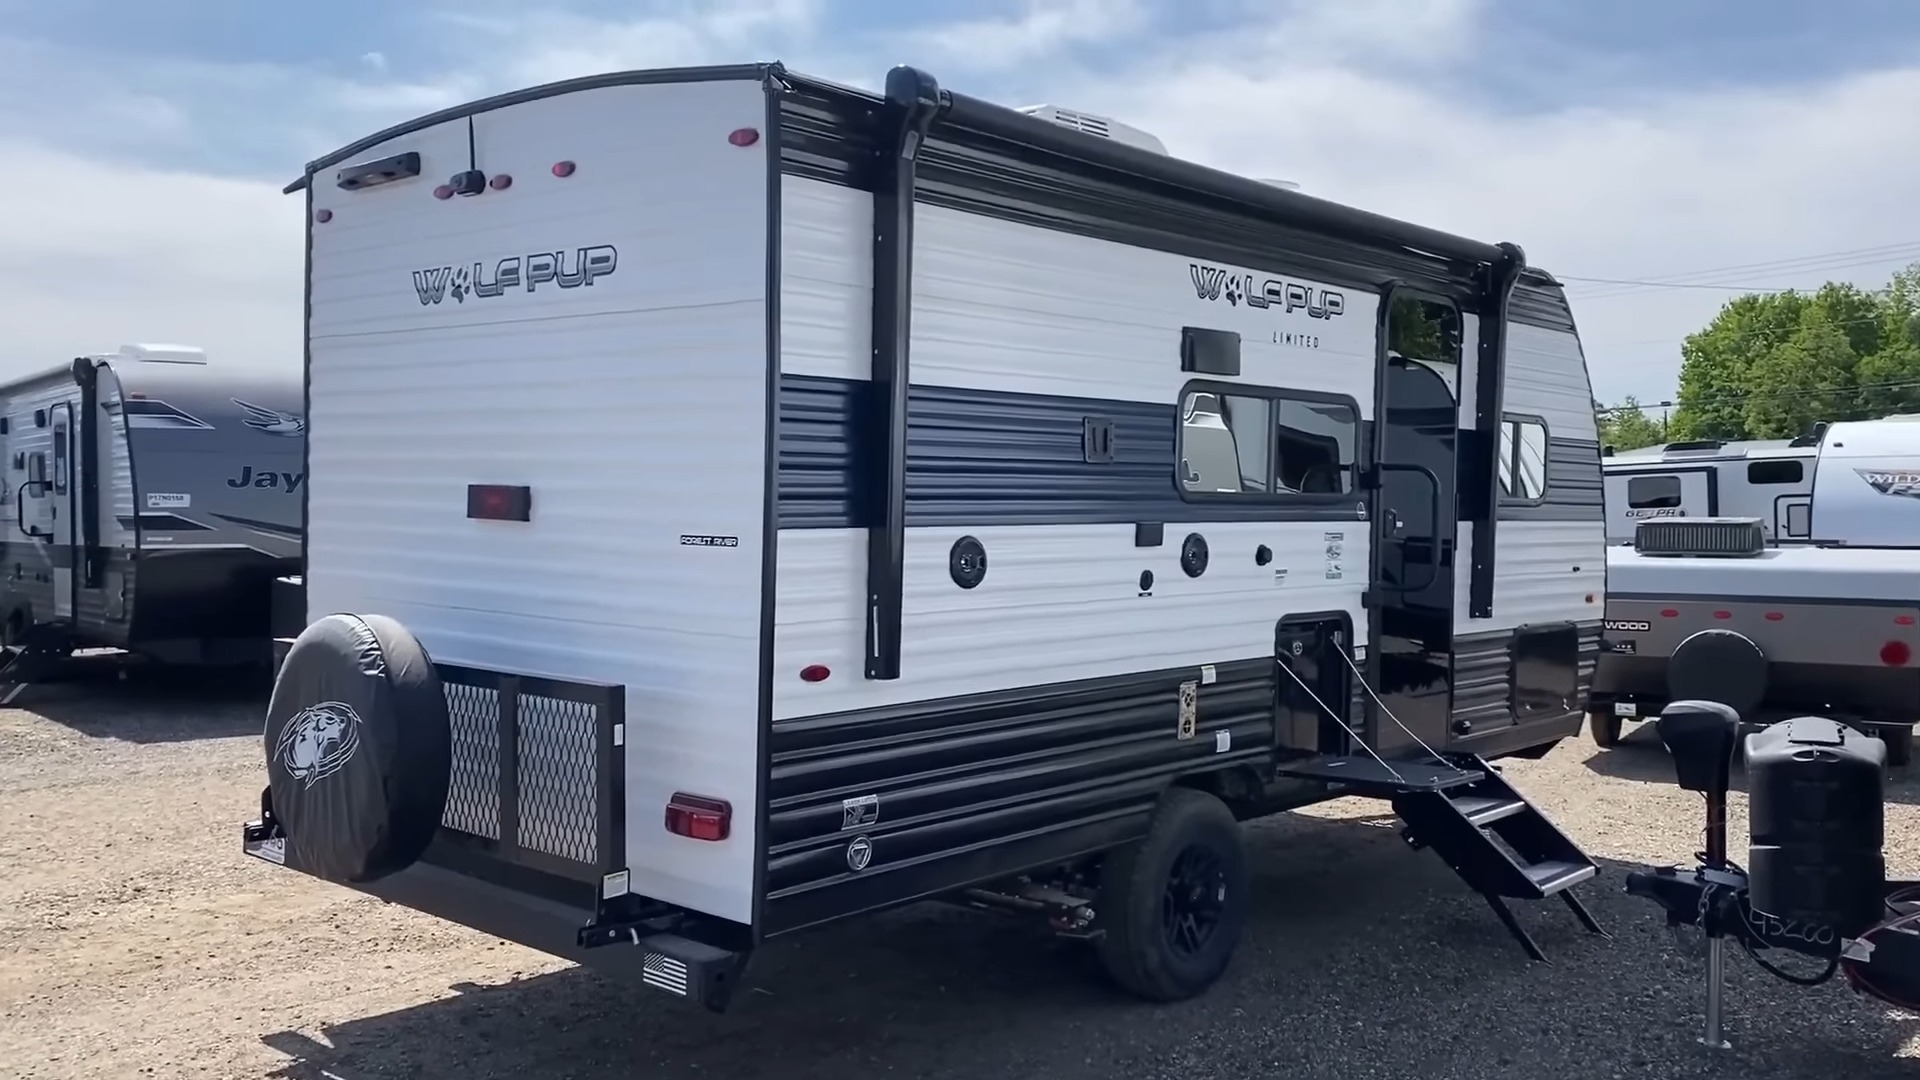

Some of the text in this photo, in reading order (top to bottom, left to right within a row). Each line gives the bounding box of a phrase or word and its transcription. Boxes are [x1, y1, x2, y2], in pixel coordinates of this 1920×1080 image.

[526, 245, 618, 292] PUP
[1286, 283, 1344, 320] PUP
[1273, 331, 1319, 349] LIMITED
[227, 466, 304, 493] Jay
[1604, 621, 1649, 631] WOOD
